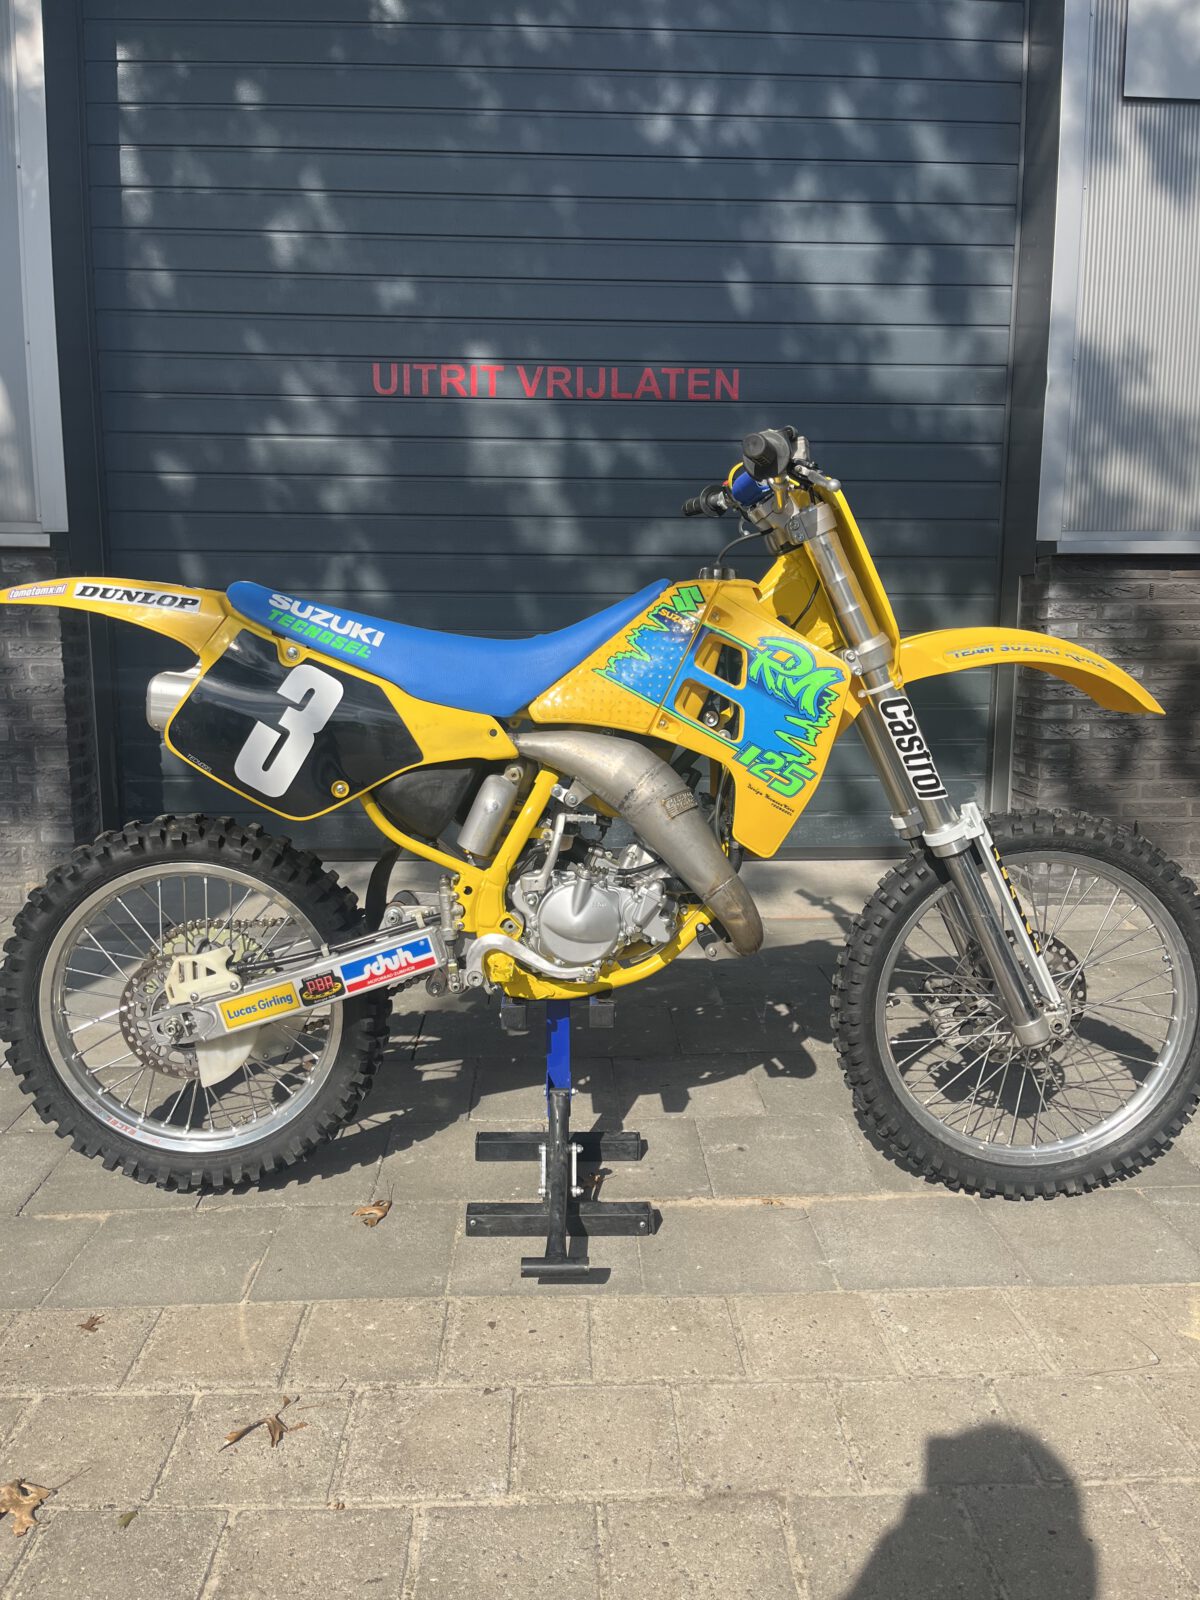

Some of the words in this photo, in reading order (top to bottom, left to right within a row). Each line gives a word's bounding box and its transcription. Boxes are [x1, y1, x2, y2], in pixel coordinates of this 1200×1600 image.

[372, 362, 504, 398] UITRIT
[516, 365, 740, 401] VRIJLATEN
[75, 585, 199, 609] DUNLOP
[268, 593, 385, 647] SUZUKI
[267, 609, 371, 659] TECNOSEL
[234, 664, 344, 797] 3
[878, 697, 947, 799] Castrol
[733, 742, 817, 798] 125
[226, 1006, 258, 1020] Lucas
[257, 993, 294, 1010] Girling
